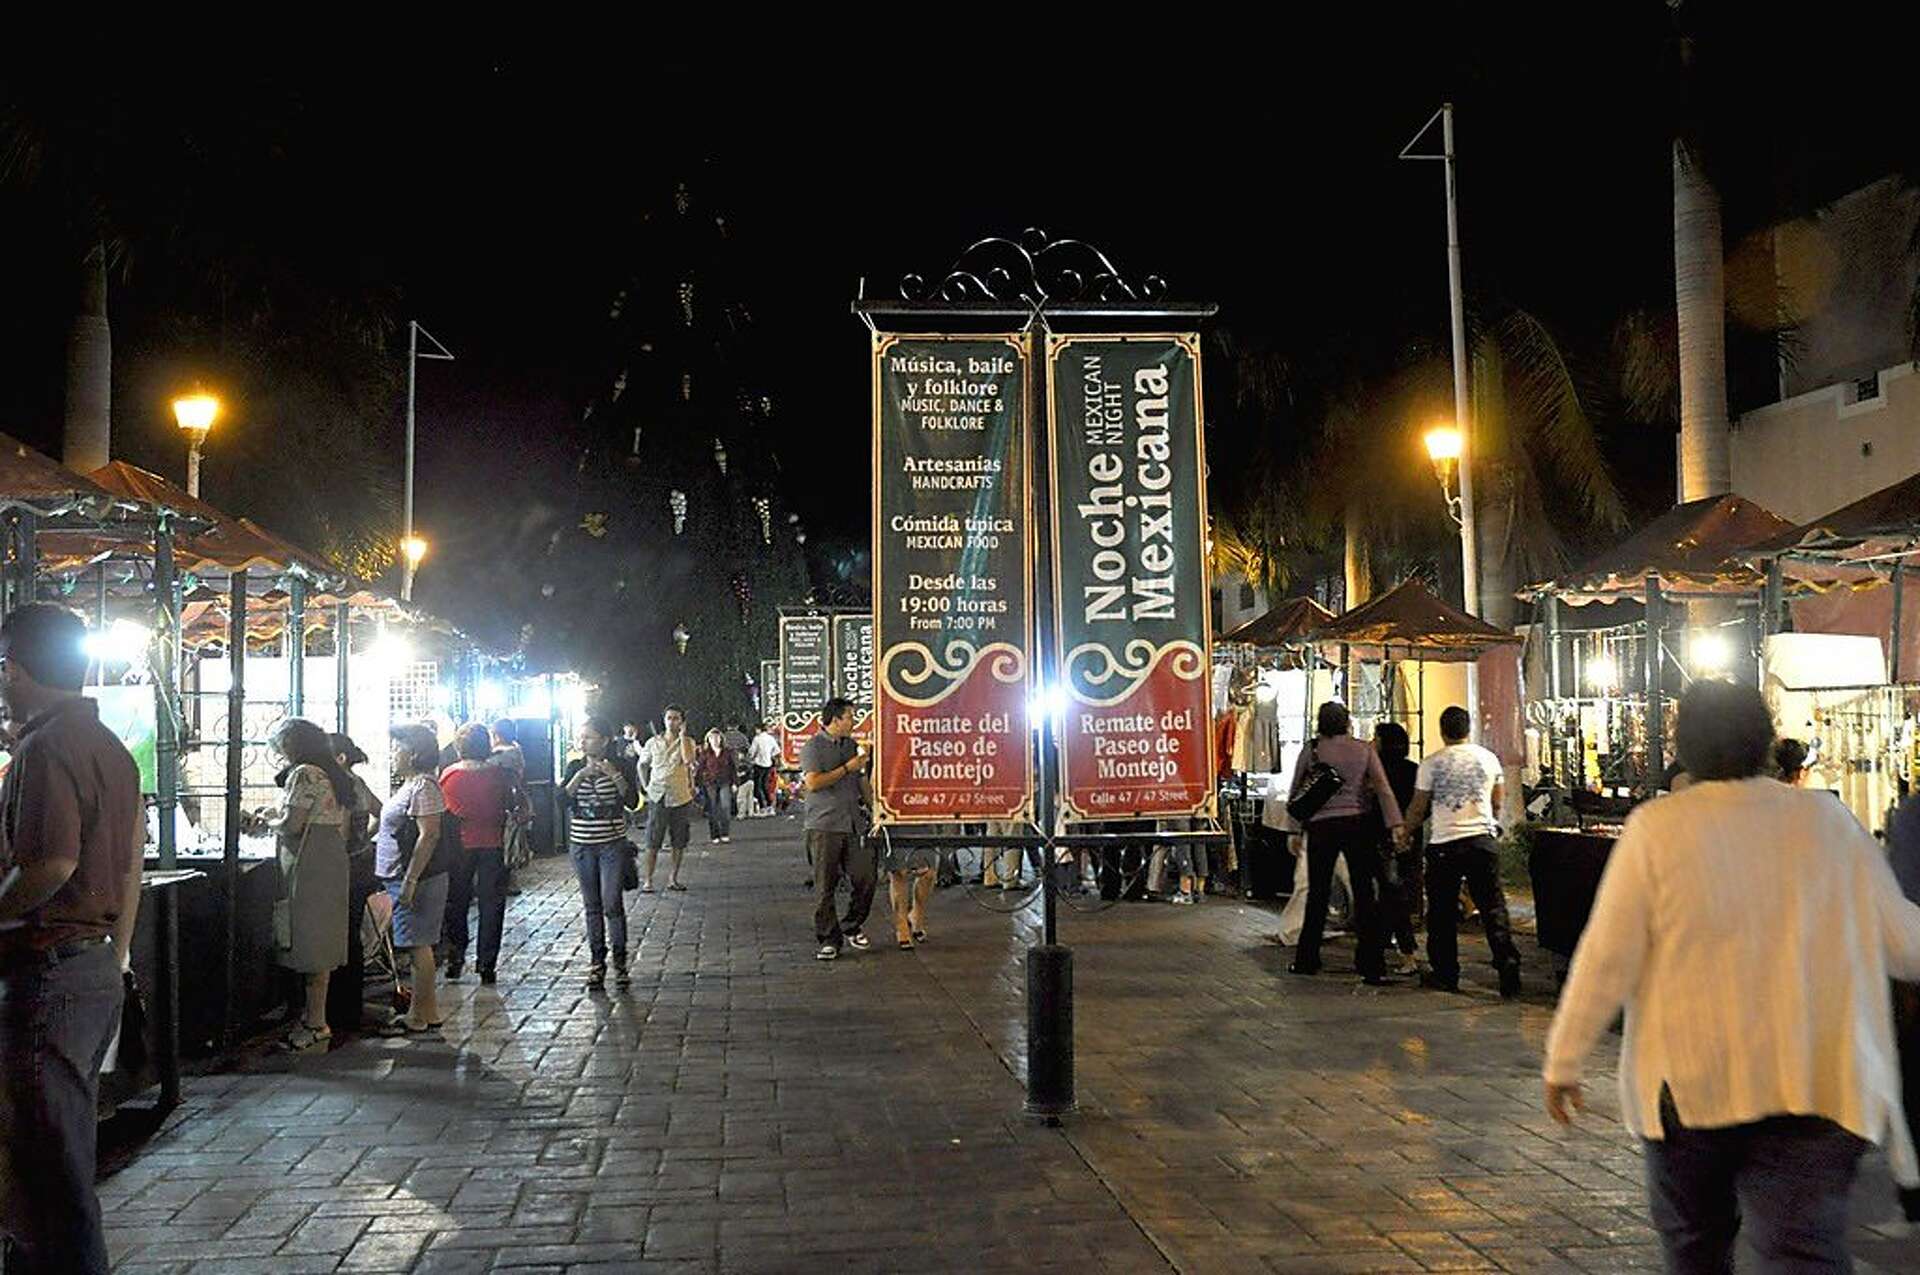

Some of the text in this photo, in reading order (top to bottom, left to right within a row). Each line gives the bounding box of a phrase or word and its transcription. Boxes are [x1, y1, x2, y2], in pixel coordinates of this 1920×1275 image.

[891, 356, 1014, 375] Música, baile
[906, 379, 998, 399] y folklore
[950, 399, 991, 413] DANCE
[994, 399, 1004, 412] &
[1083, 356, 1104, 445] MEXICAN
[1103, 381, 1124, 445] NIGHT
[921, 416, 985, 430] FOLKLORE
[903, 455, 1002, 473] Artesanías
[912, 475, 993, 489] HANDCRAFTS
[1125, 363, 1176, 622] Mexicana
[906, 536, 999, 549] MEXICAN FOOD
[1077, 453, 1127, 624] Noche
[908, 574, 997, 590] Desde las
[900, 596, 1008, 613] 19:00 horas
[910, 616, 996, 630] From 7:00 PM
[896, 712, 1010, 734] Remate del
[1080, 708, 1193, 734] Remate del
[909, 735, 997, 757] Paseo de
[1094, 733, 1180, 757] Paseo de
[912, 758, 995, 786] Montejo
[1097, 756, 1177, 783] Montejo
[902, 792, 929, 805] Calle
[931, 792, 946, 804] 47
[1090, 792, 1116, 804] Calle
[1118, 791, 1132, 803] 47
